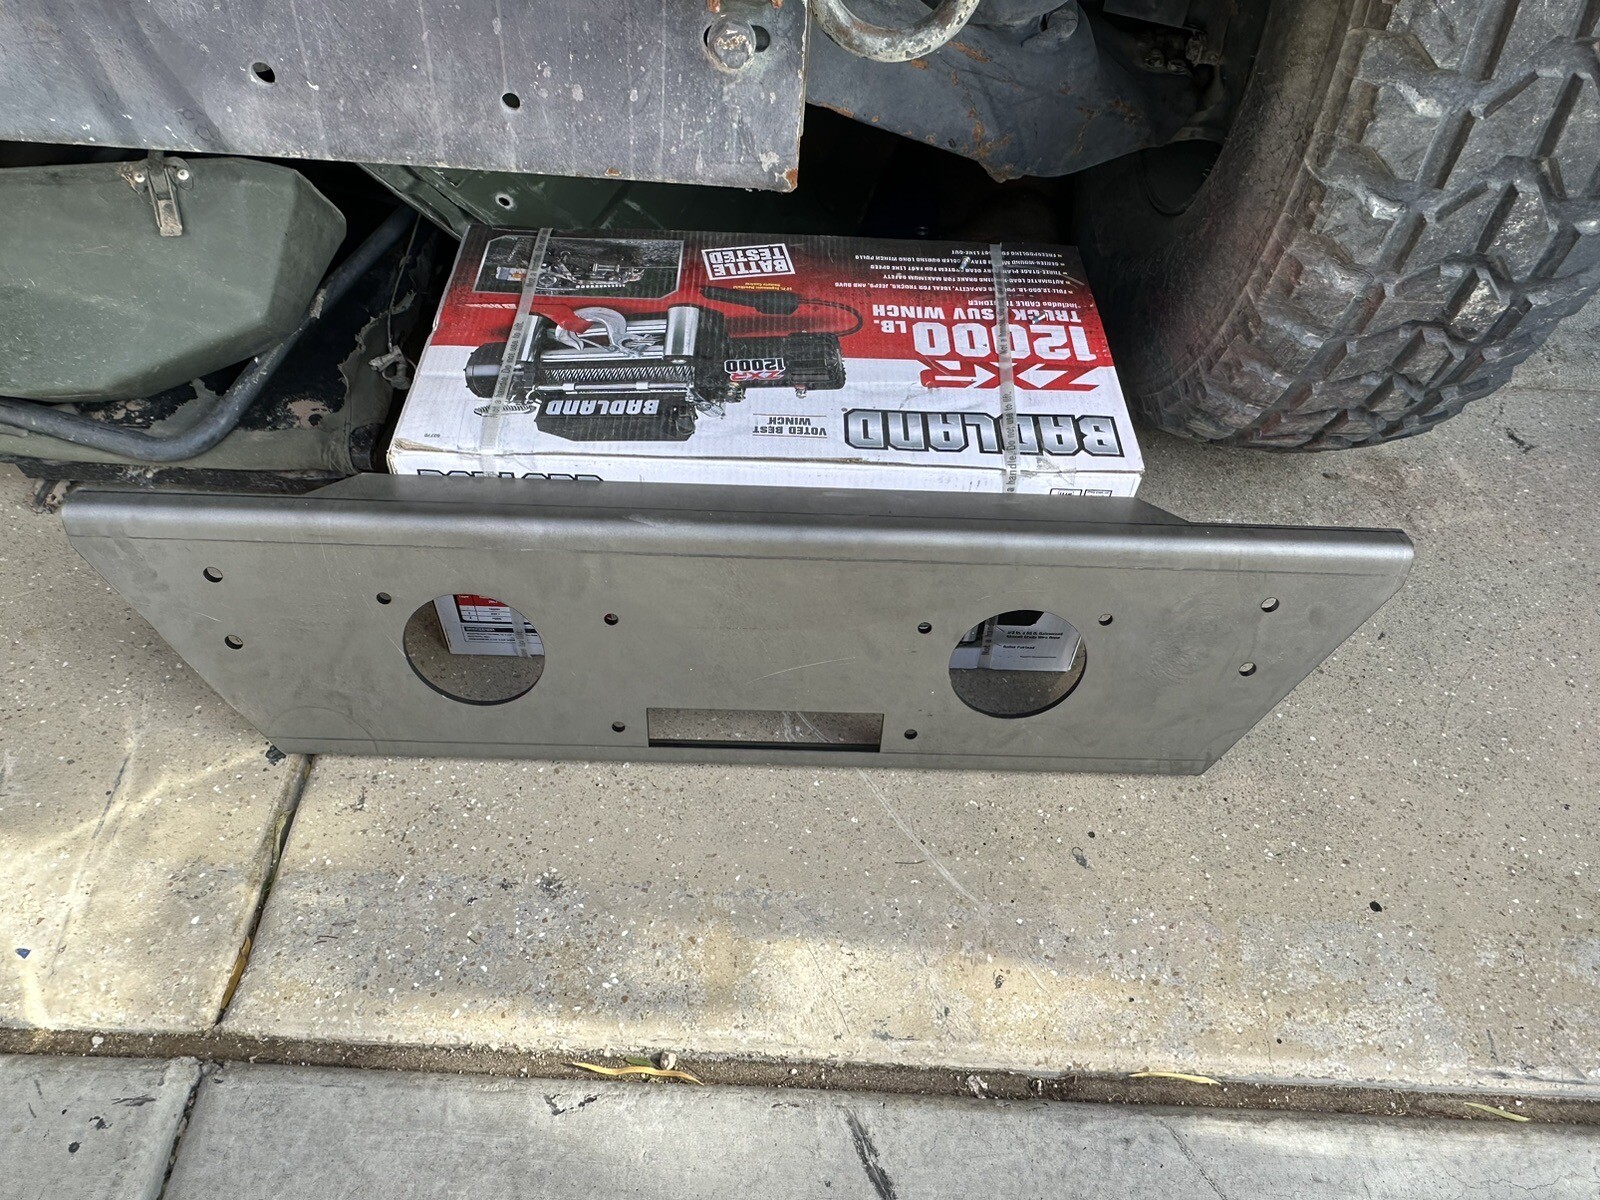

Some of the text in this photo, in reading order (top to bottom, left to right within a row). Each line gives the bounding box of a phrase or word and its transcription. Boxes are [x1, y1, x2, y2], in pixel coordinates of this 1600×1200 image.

[708, 247, 785, 263] TESTED
[712, 259, 788, 276] BATTLE
[872, 304, 945, 320] WINCH
[953, 307, 993, 320] SUV
[874, 320, 906, 333] LB.
[912, 322, 1096, 361] 12000
[724, 358, 785, 372] 12000
[730, 371, 784, 381] ZXR
[916, 356, 1100, 392] ZXR
[545, 400, 659, 415] BADLAND
[767, 416, 811, 426] WINCH
[752, 425, 827, 436] VOTED BEST
[844, 409, 1124, 458] BADLAND
